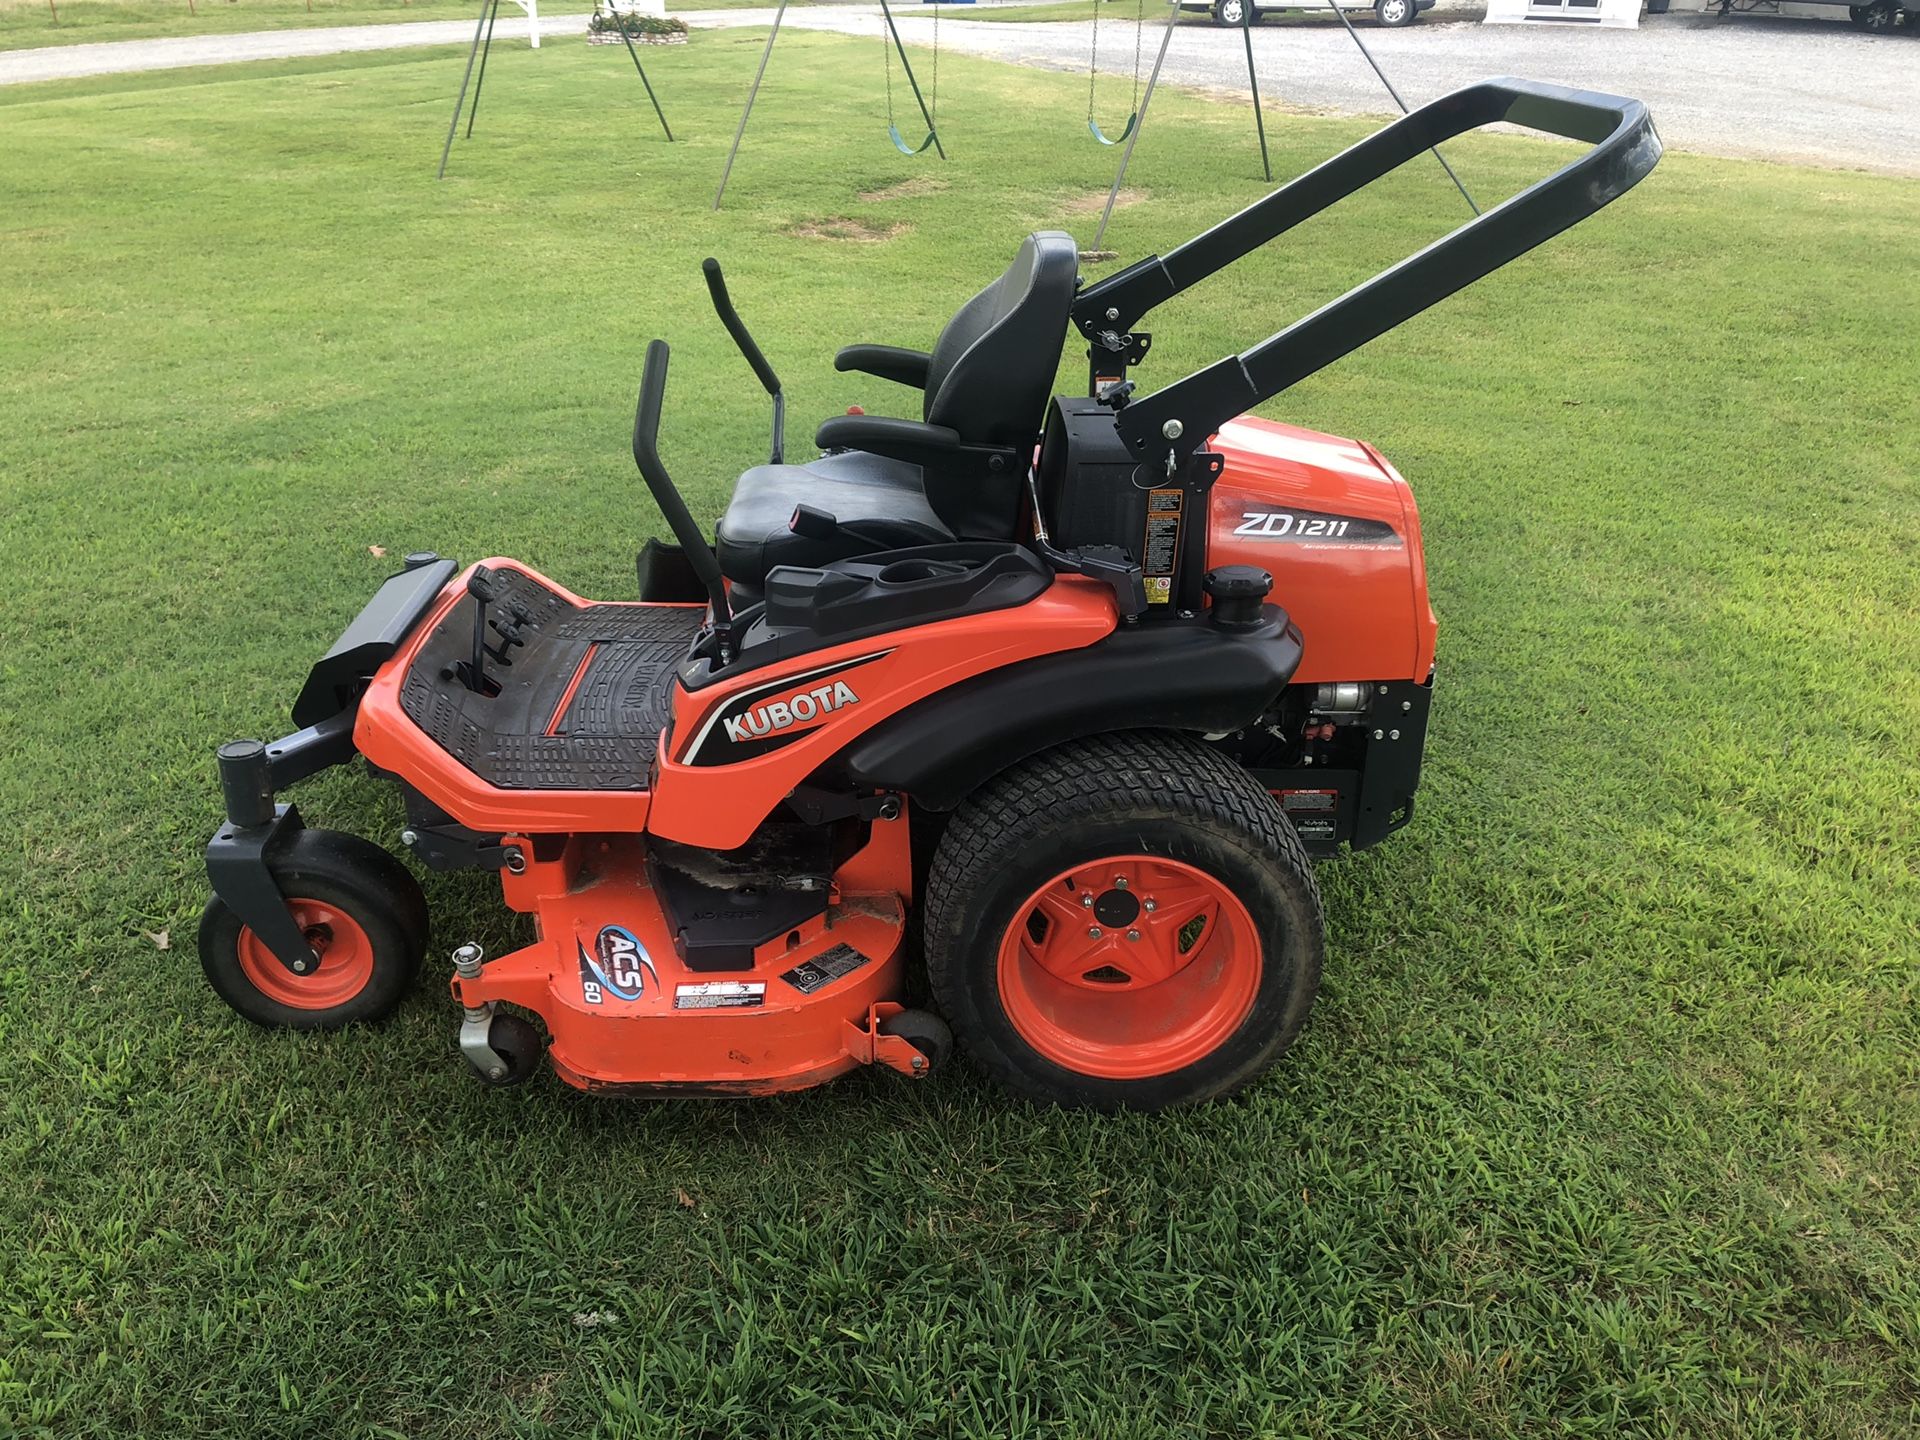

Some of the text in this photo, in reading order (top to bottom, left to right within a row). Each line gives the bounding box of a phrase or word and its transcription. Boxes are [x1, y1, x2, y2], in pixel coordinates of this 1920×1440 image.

[620, 660, 659, 710] KUBOTA
[722, 680, 861, 744] KUBOTA
[609, 934, 643, 988] ACS
[583, 981, 602, 1003] 60
